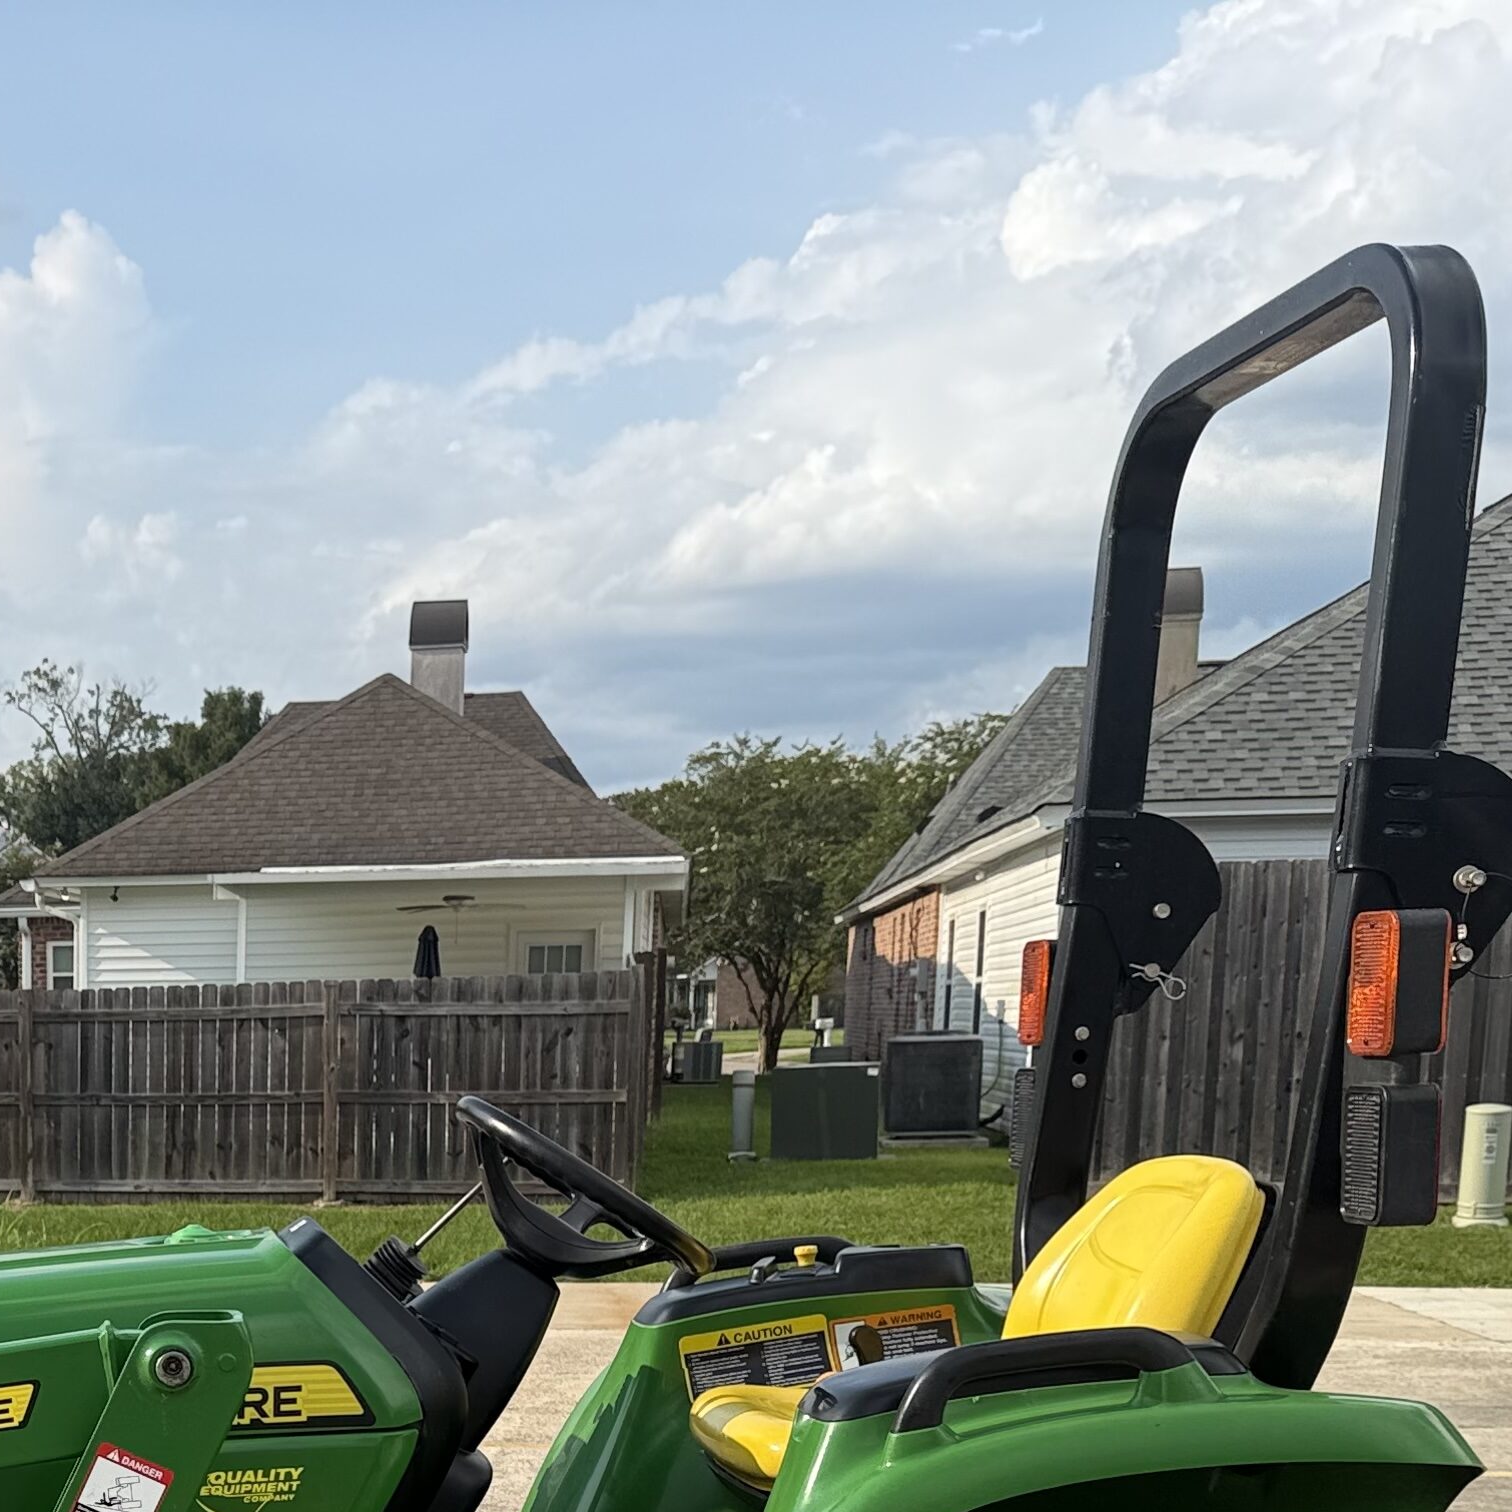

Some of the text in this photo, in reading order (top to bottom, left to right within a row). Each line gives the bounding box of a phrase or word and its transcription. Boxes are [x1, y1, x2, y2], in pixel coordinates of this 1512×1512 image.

[890, 1310, 942, 1325] WARNING
[733, 1324, 793, 1343] CAUTION
[121, 1455, 164, 1481] DANGER
[207, 1466, 304, 1487] QUALITY
[200, 1480, 301, 1496] EQUIPMENT
[243, 1493, 295, 1503] COMPANY
